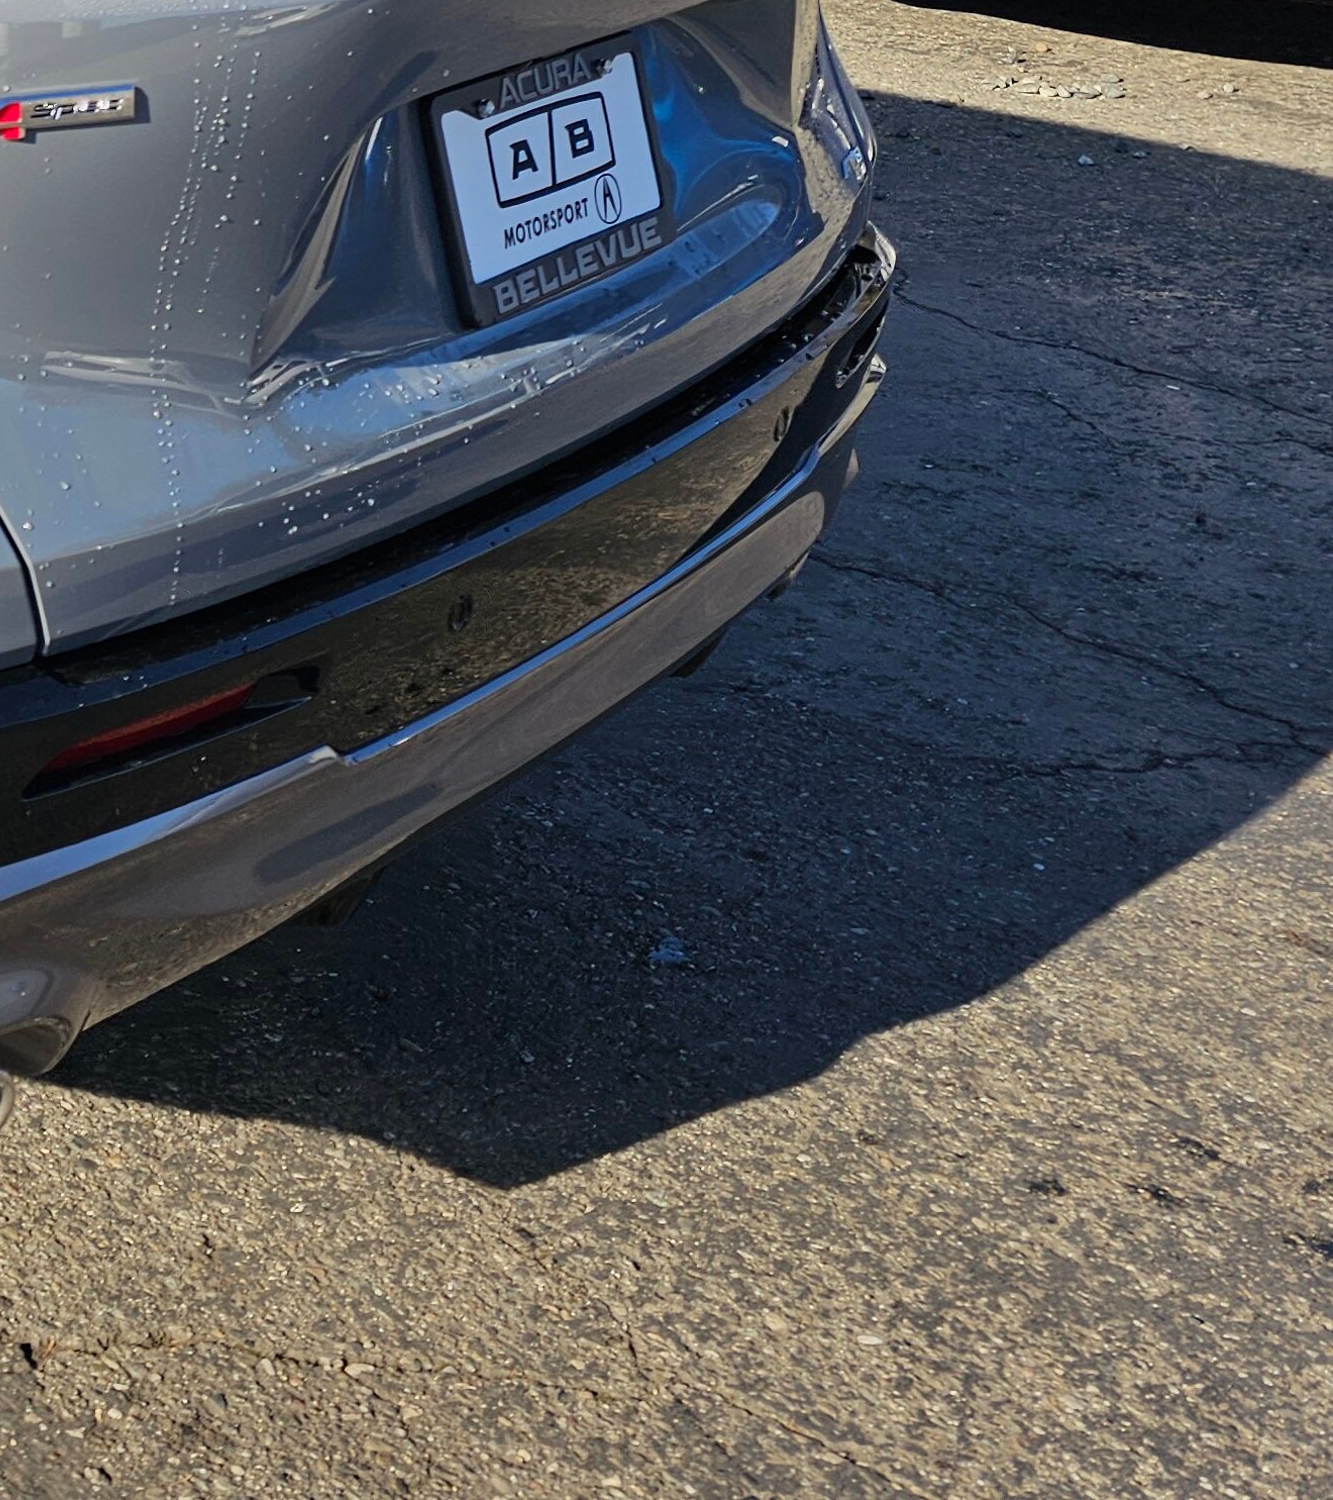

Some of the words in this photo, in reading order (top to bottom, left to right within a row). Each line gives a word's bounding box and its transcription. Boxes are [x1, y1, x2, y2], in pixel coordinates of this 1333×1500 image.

[499, 55, 592, 108] ACURA
[509, 139, 539, 180] A
[564, 118, 595, 159] B
[503, 198, 588, 250] MOTORSPORT
[493, 216, 662, 314] BELLEVUE
